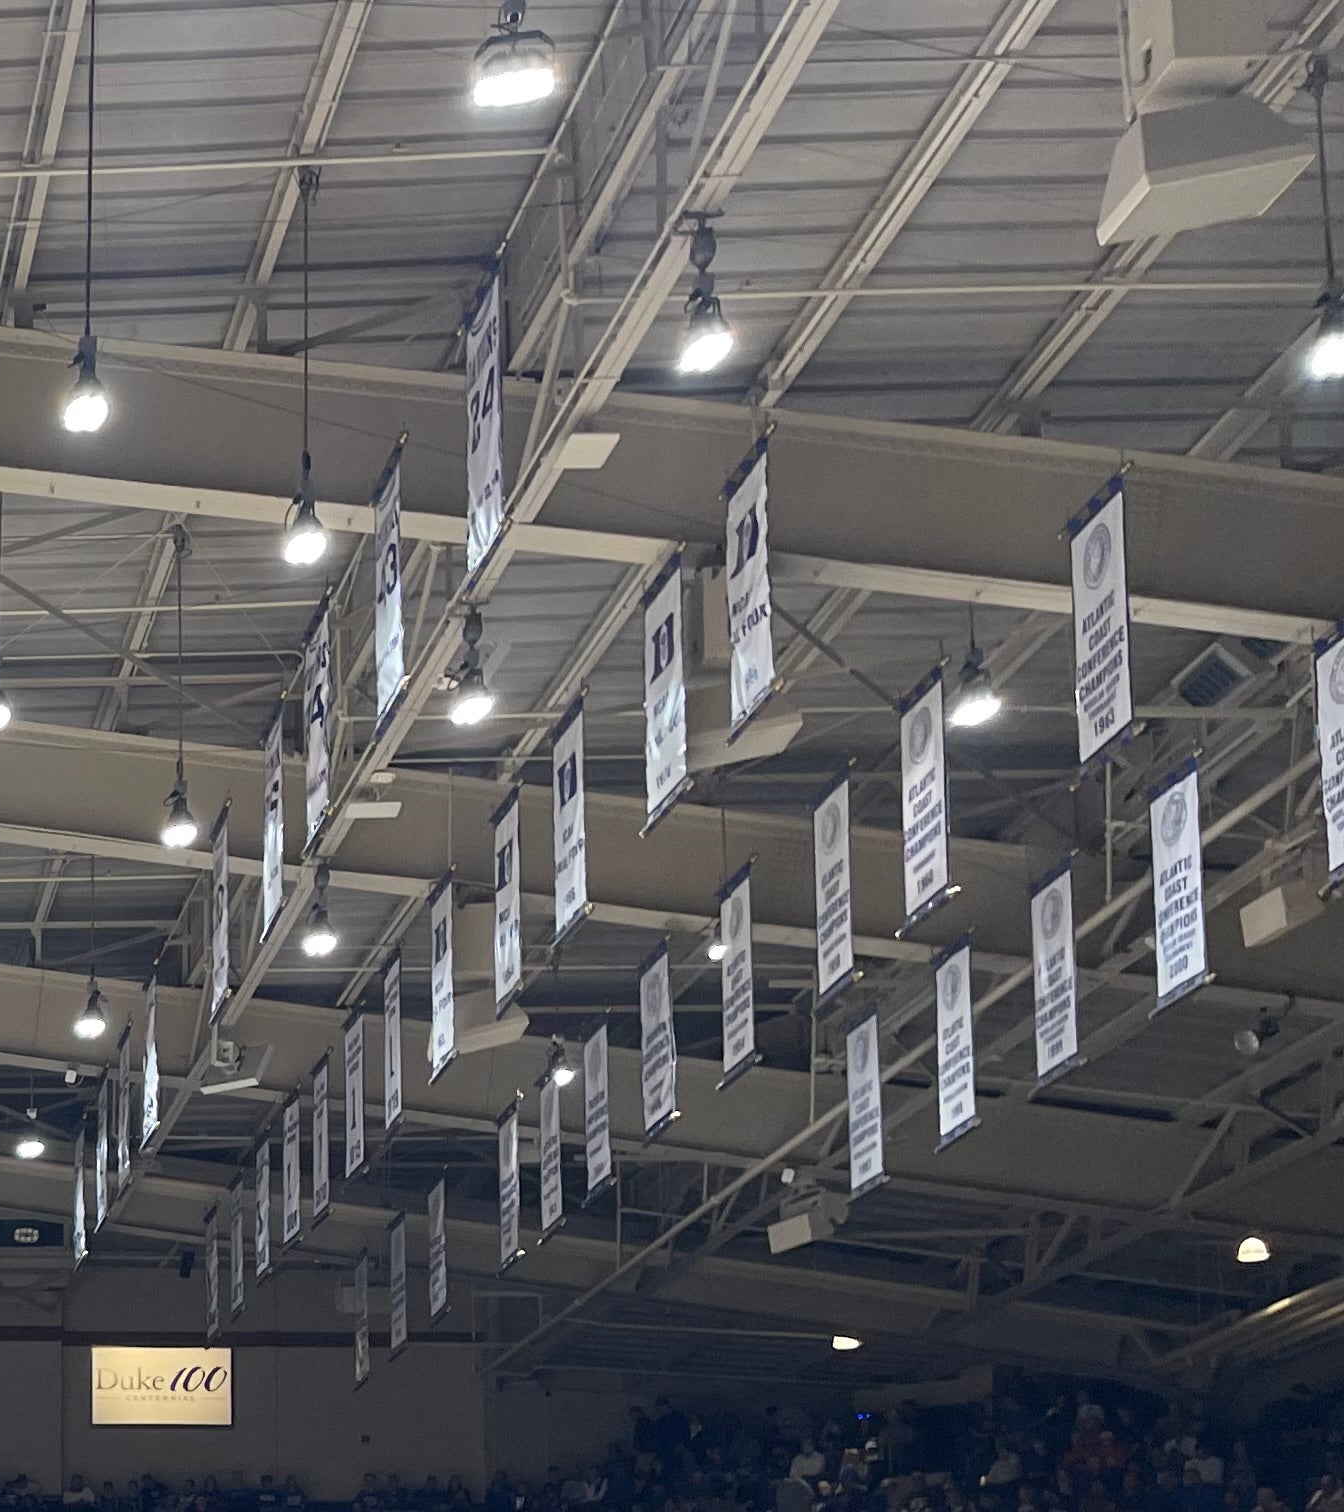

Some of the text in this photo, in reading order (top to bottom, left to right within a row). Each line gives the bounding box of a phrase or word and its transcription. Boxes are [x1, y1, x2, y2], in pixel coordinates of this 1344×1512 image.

[1081, 588, 1115, 636] ATLANTIC
[1088, 615, 1112, 651] COAST
[1077, 624, 1125, 682] CONFERENCE
[1079, 648, 1124, 702] CHAMPIONS
[95, 1366, 228, 1392] Duke 100
[126, 1394, 194, 1402] CENTENNIAL
